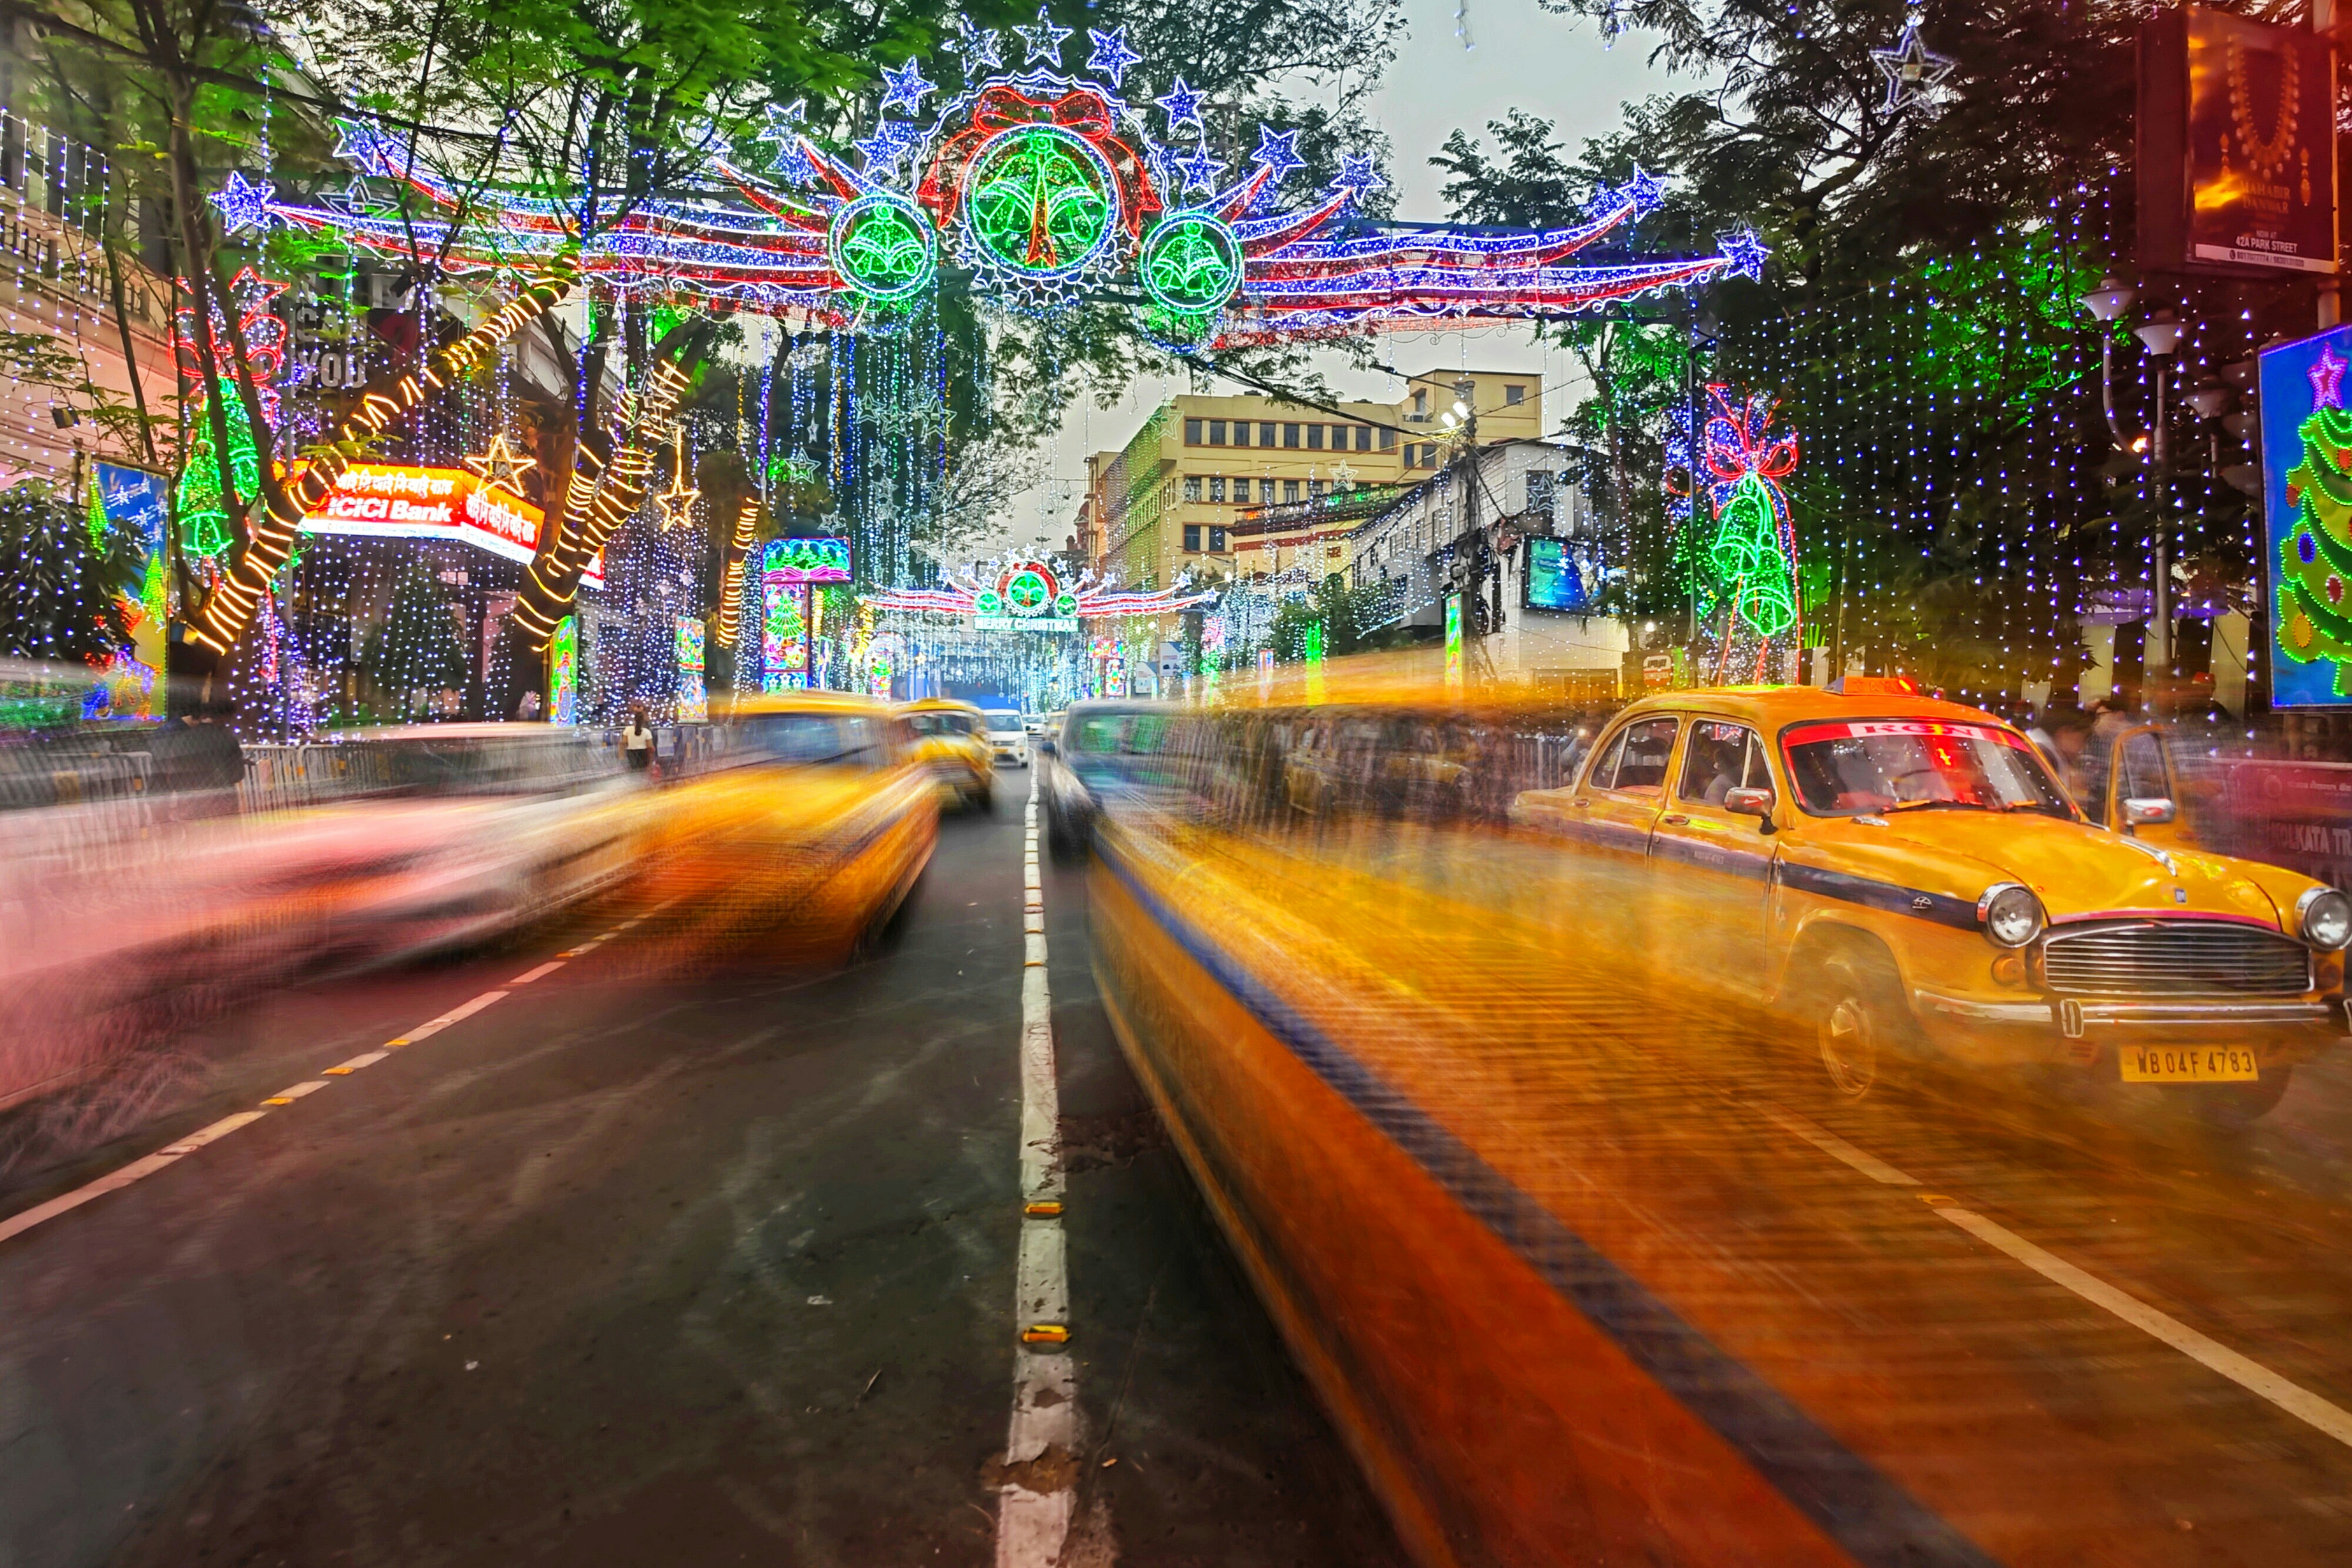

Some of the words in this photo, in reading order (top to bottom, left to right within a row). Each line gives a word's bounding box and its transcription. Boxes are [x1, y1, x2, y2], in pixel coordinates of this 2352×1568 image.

[2235, 236, 2250, 248] 42A
[2251, 238, 2271, 250] PARK
[2271, 240, 2298, 253] STREET
[327, 496, 389, 518] ICICI
[390, 500, 453, 522] Bank
[974, 617, 1013, 630] MERRY
[1014, 618, 1078, 632] CHRISTMAS
[2207, 1051, 2252, 1073] 4783
